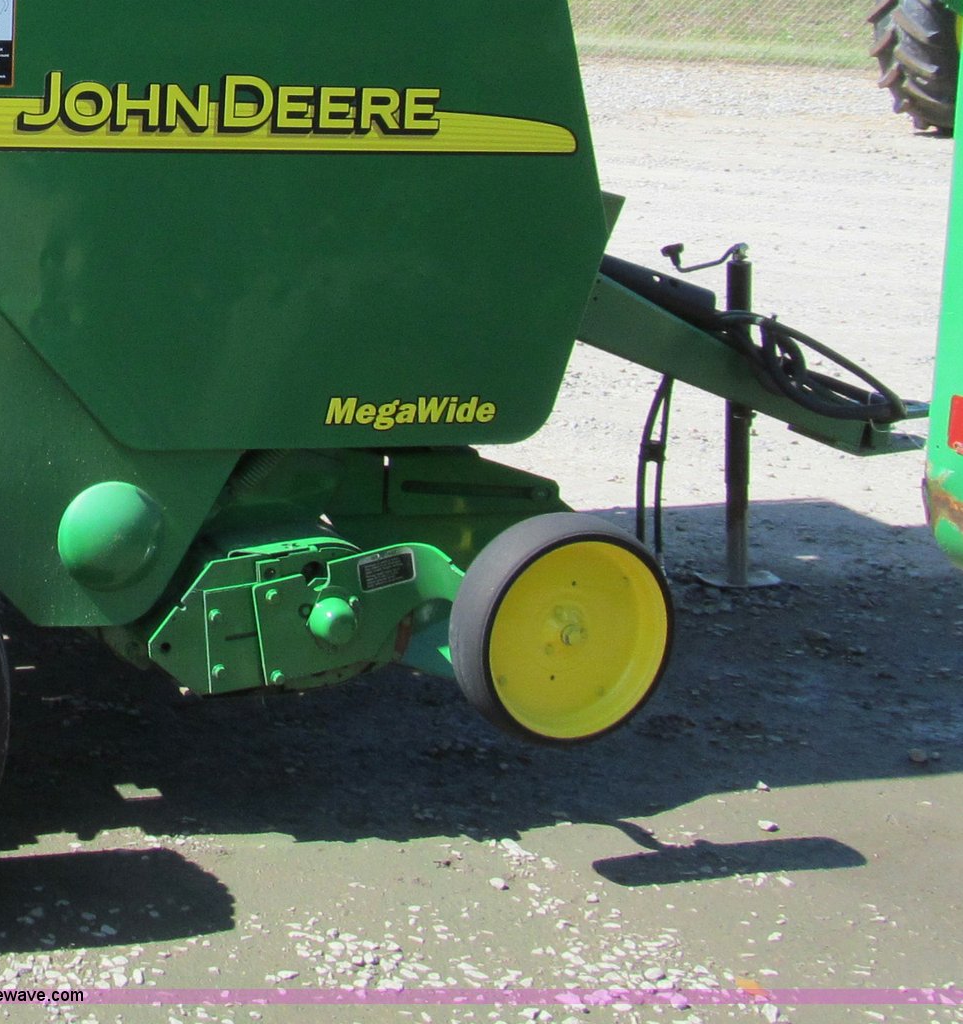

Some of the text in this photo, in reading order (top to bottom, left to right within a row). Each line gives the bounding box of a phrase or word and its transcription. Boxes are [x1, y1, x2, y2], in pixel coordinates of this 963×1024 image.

[18, 70, 441, 136] JOHN DEERE
[324, 395, 497, 431] MegaWide
